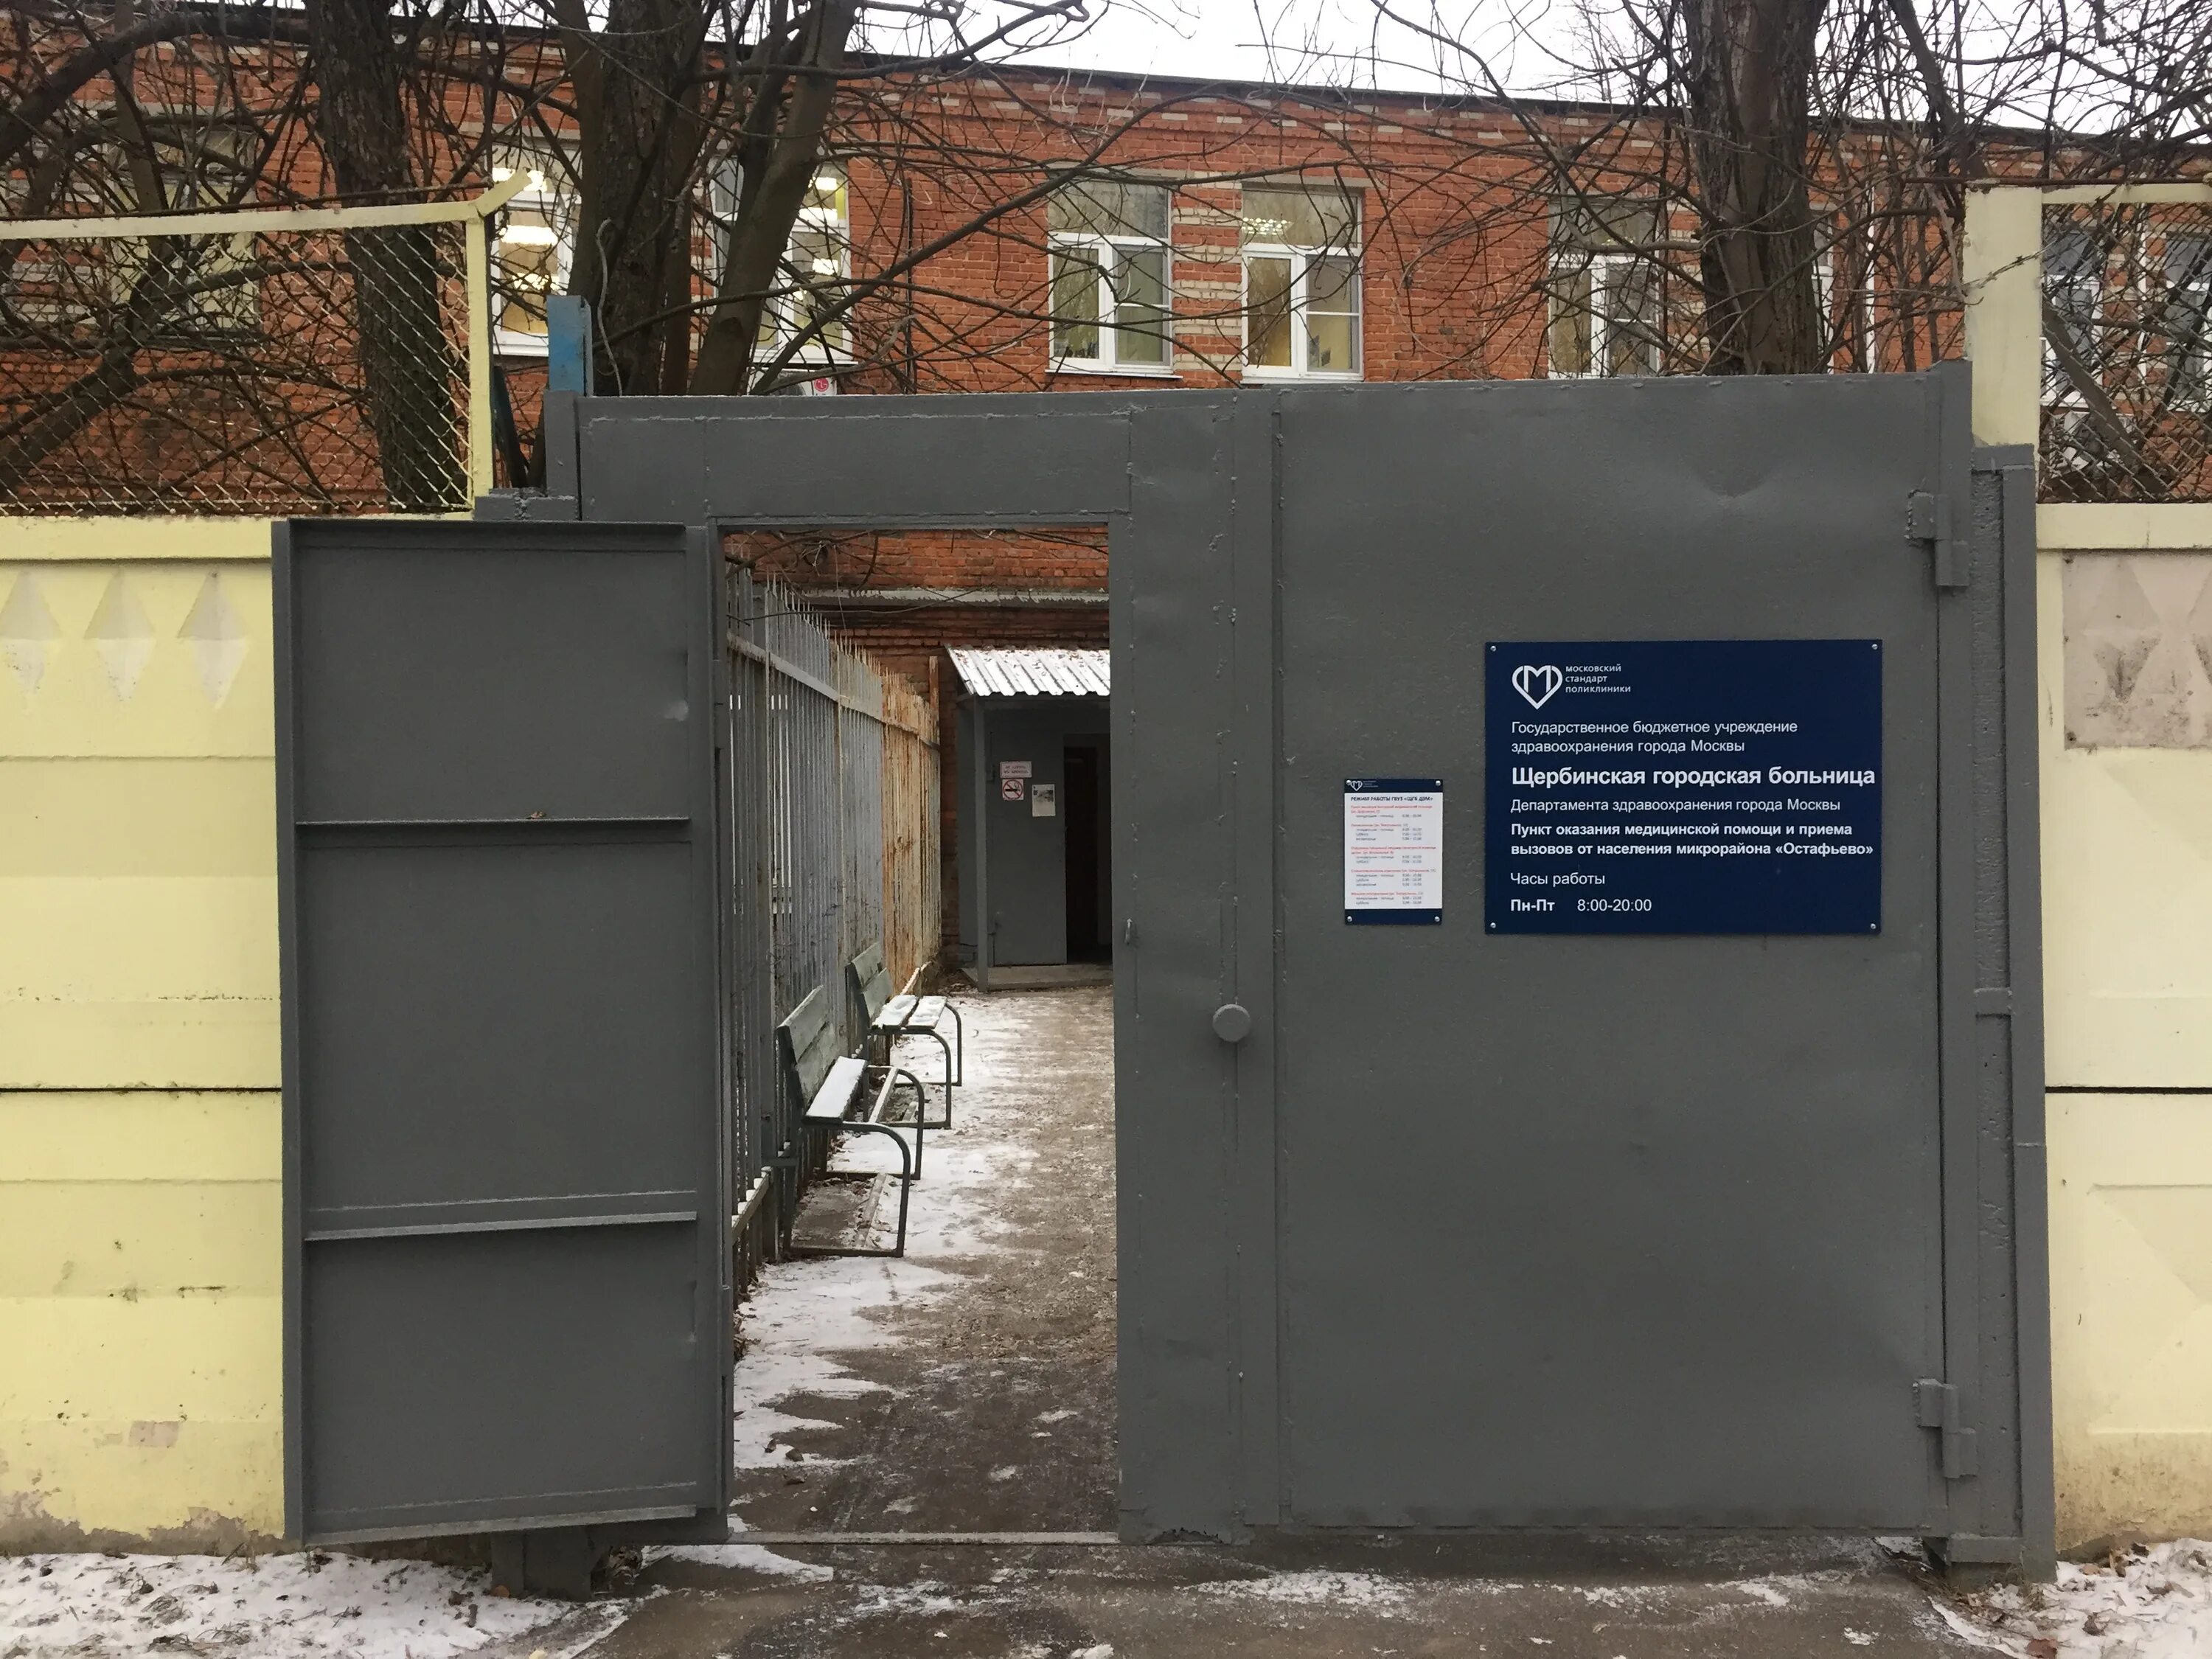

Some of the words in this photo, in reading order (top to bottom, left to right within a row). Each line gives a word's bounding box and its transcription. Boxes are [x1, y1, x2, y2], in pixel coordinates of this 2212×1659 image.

[1566, 664, 1621, 672] московский
[1512, 722, 1629, 736] Государственное
[1633, 721, 1710, 734] бюджетное
[1714, 723, 1798, 735] учреждение
[1512, 742, 1633, 755] здравоохранения
[1638, 742, 1686, 754] города
[1691, 740, 1745, 751] Москвы
[1512, 767, 1645, 788] Щербинская
[1653, 771, 1761, 788] городская
[1769, 766, 1875, 787] больница
[1511, 799, 1608, 813] Департамента
[1613, 801, 1732, 813] здравоохранения
[1736, 801, 1782, 813] города
[1787, 799, 1840, 810] Москвы
[1512, 824, 1552, 838] Пункт
[1556, 826, 1620, 835] оказания
[1625, 823, 1719, 836] медицинской
[1724, 826, 1781, 836] помощи
[1786, 826, 1794, 834] и
[1799, 826, 1852, 838] приема
[1512, 846, 1573, 854] вызовов
[1577, 846, 1593, 854] от
[1597, 846, 1672, 854] населения
[1677, 842, 1771, 857] микрорайона
[1775, 842, 1873, 857] «Остафьево»
[1511, 873, 1548, 884] Часы
[1553, 872, 1604, 887] работы
[1511, 899, 1555, 911] Пн-Пт
[1577, 899, 1652, 911] 8:00-20:00
